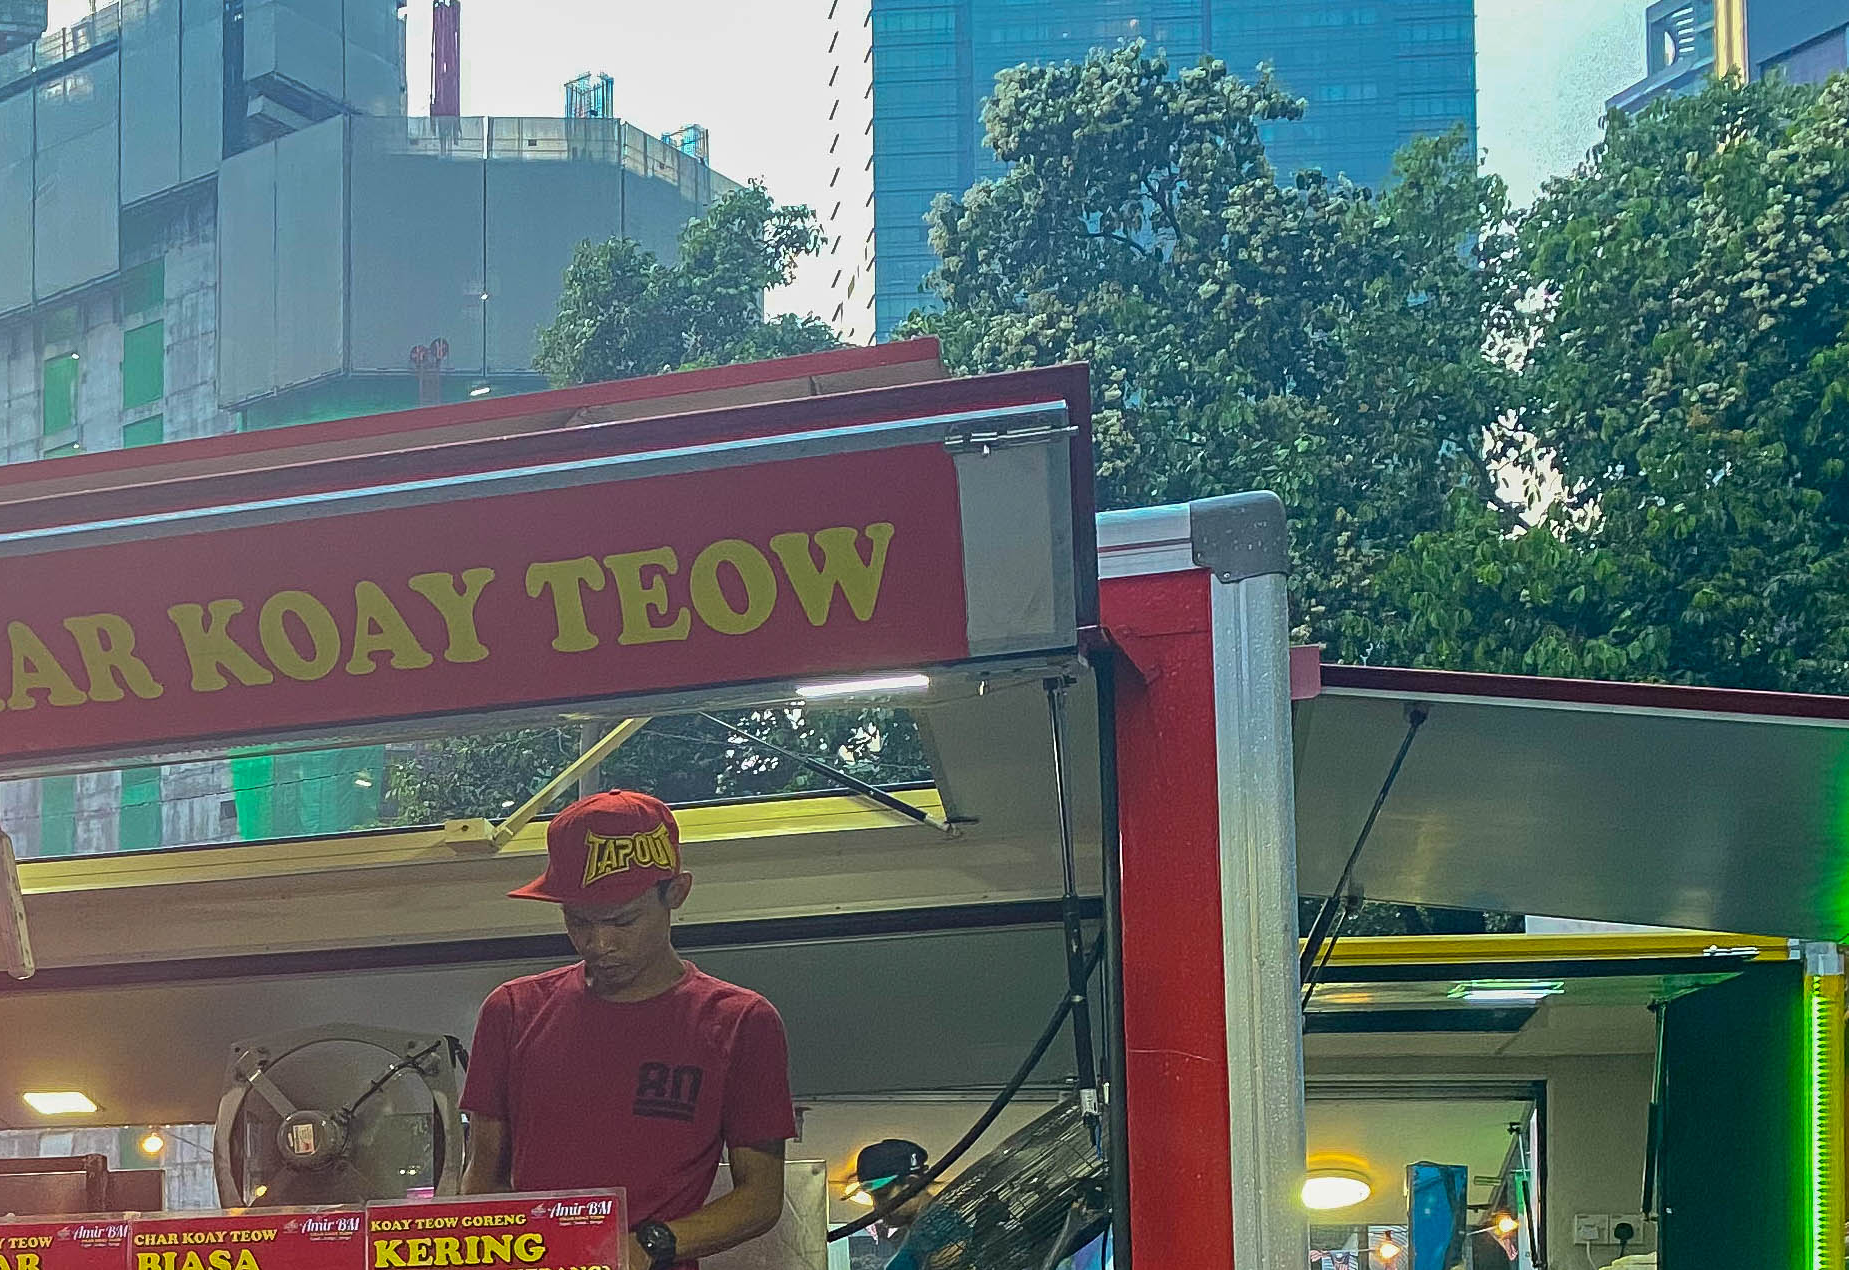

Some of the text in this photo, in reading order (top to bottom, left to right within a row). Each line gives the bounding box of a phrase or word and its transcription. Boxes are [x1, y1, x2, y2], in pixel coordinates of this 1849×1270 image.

[168, 567, 495, 693] KOAY
[526, 522, 895, 654] TEOW
[583, 822, 677, 888] TAPOUT
[336, 1217, 360, 1231] BM
[370, 1214, 527, 1232] KOAY TEOW GORENG
[8, 1235, 54, 1249] TEOW
[134, 1233, 179, 1246] CHAR
[182, 1231, 227, 1244] KOAY
[230, 1229, 278, 1242] TEOW
[373, 1232, 547, 1269] KERING
